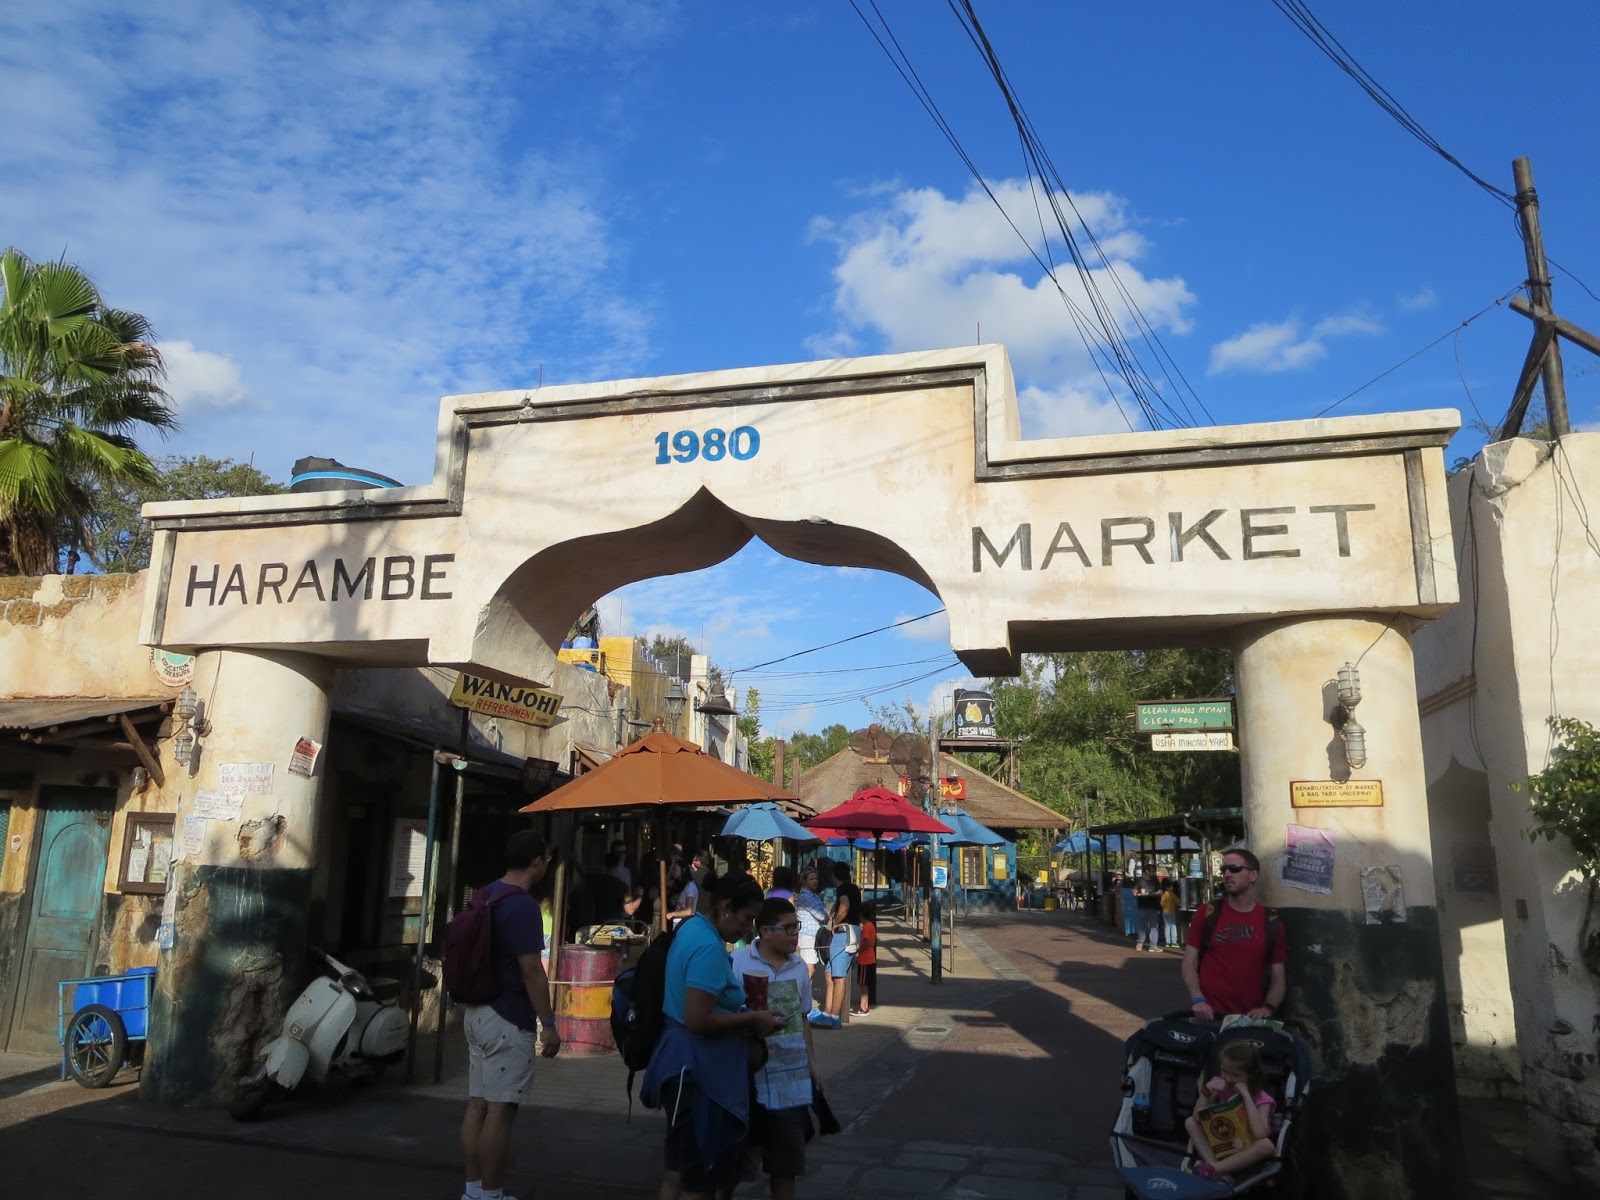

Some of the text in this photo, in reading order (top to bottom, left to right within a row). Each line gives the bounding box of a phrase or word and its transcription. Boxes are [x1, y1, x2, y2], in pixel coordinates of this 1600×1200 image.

[655, 425, 760, 465] 1980
[971, 503, 1376, 573] MARKET
[185, 553, 455, 607] HARAMBE
[163, 668, 191, 678] TREASURE
[462, 674, 558, 715] WANJOHI
[475, 698, 536, 720] REFRESHMENT
[1142, 706, 1227, 715] CLEAN HANDS MEANS
[958, 727, 978, 736] FRESH
[1143, 717, 1175, 725] CLEAN
